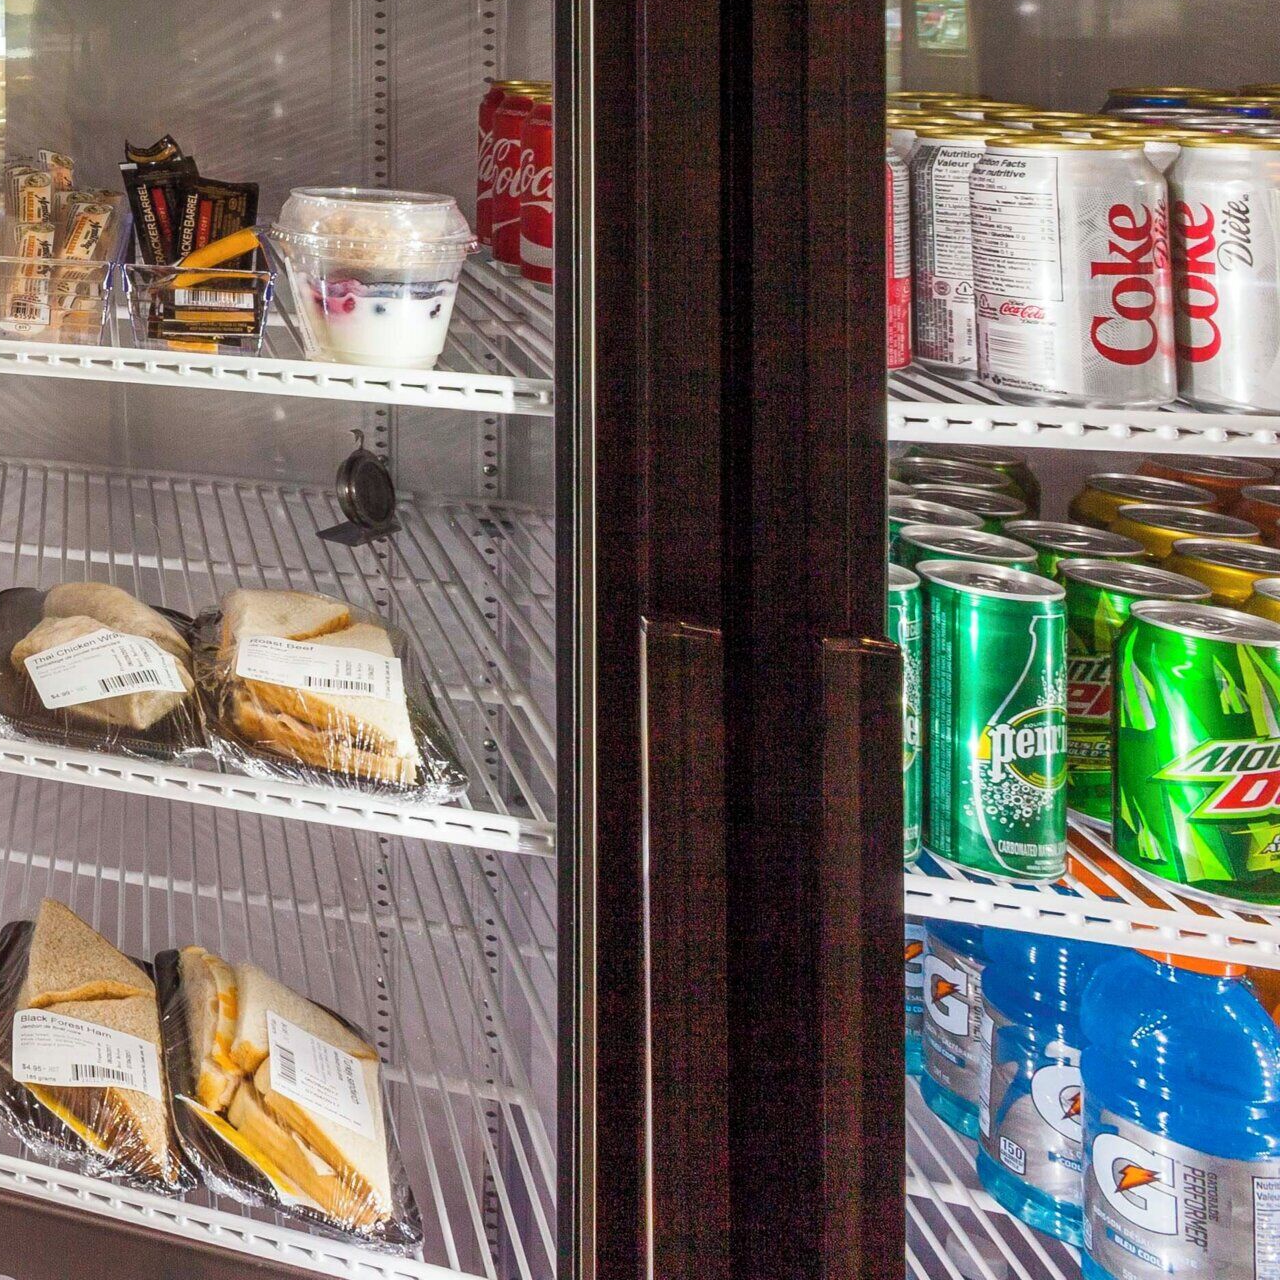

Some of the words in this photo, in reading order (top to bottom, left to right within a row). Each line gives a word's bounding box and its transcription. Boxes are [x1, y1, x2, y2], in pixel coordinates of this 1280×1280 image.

[937, 159, 969, 168] Valeur
[940, 150, 984, 159] Nutrition
[1001, 160, 1027, 169] Facts
[986, 170, 1026, 179] nutritive
[137, 183, 155, 223] BARREL
[184, 193, 198, 228] BARREL
[146, 223, 166, 265] RACKER
[1217, 197, 1254, 274] Diète
[1090, 202, 1159, 366] Coke
[1178, 200, 1222, 364] Coke
[1000, 302, 1046, 320] Coca-Cola
[32, 648, 55, 666] Thai
[56, 639, 96, 659] Chicken
[250, 638, 283, 648] Roast
[287, 643, 314, 652] Beef
[51, 1018, 83, 1031] Forest
[87, 1026, 112, 1038] Ham
[1003, 1137, 1023, 1160] 150
[1183, 1164, 1208, 1251] PERFORMER
[1207, 1170, 1218, 1222] GATORADE
[1114, 1233, 1135, 1253] BLEU
